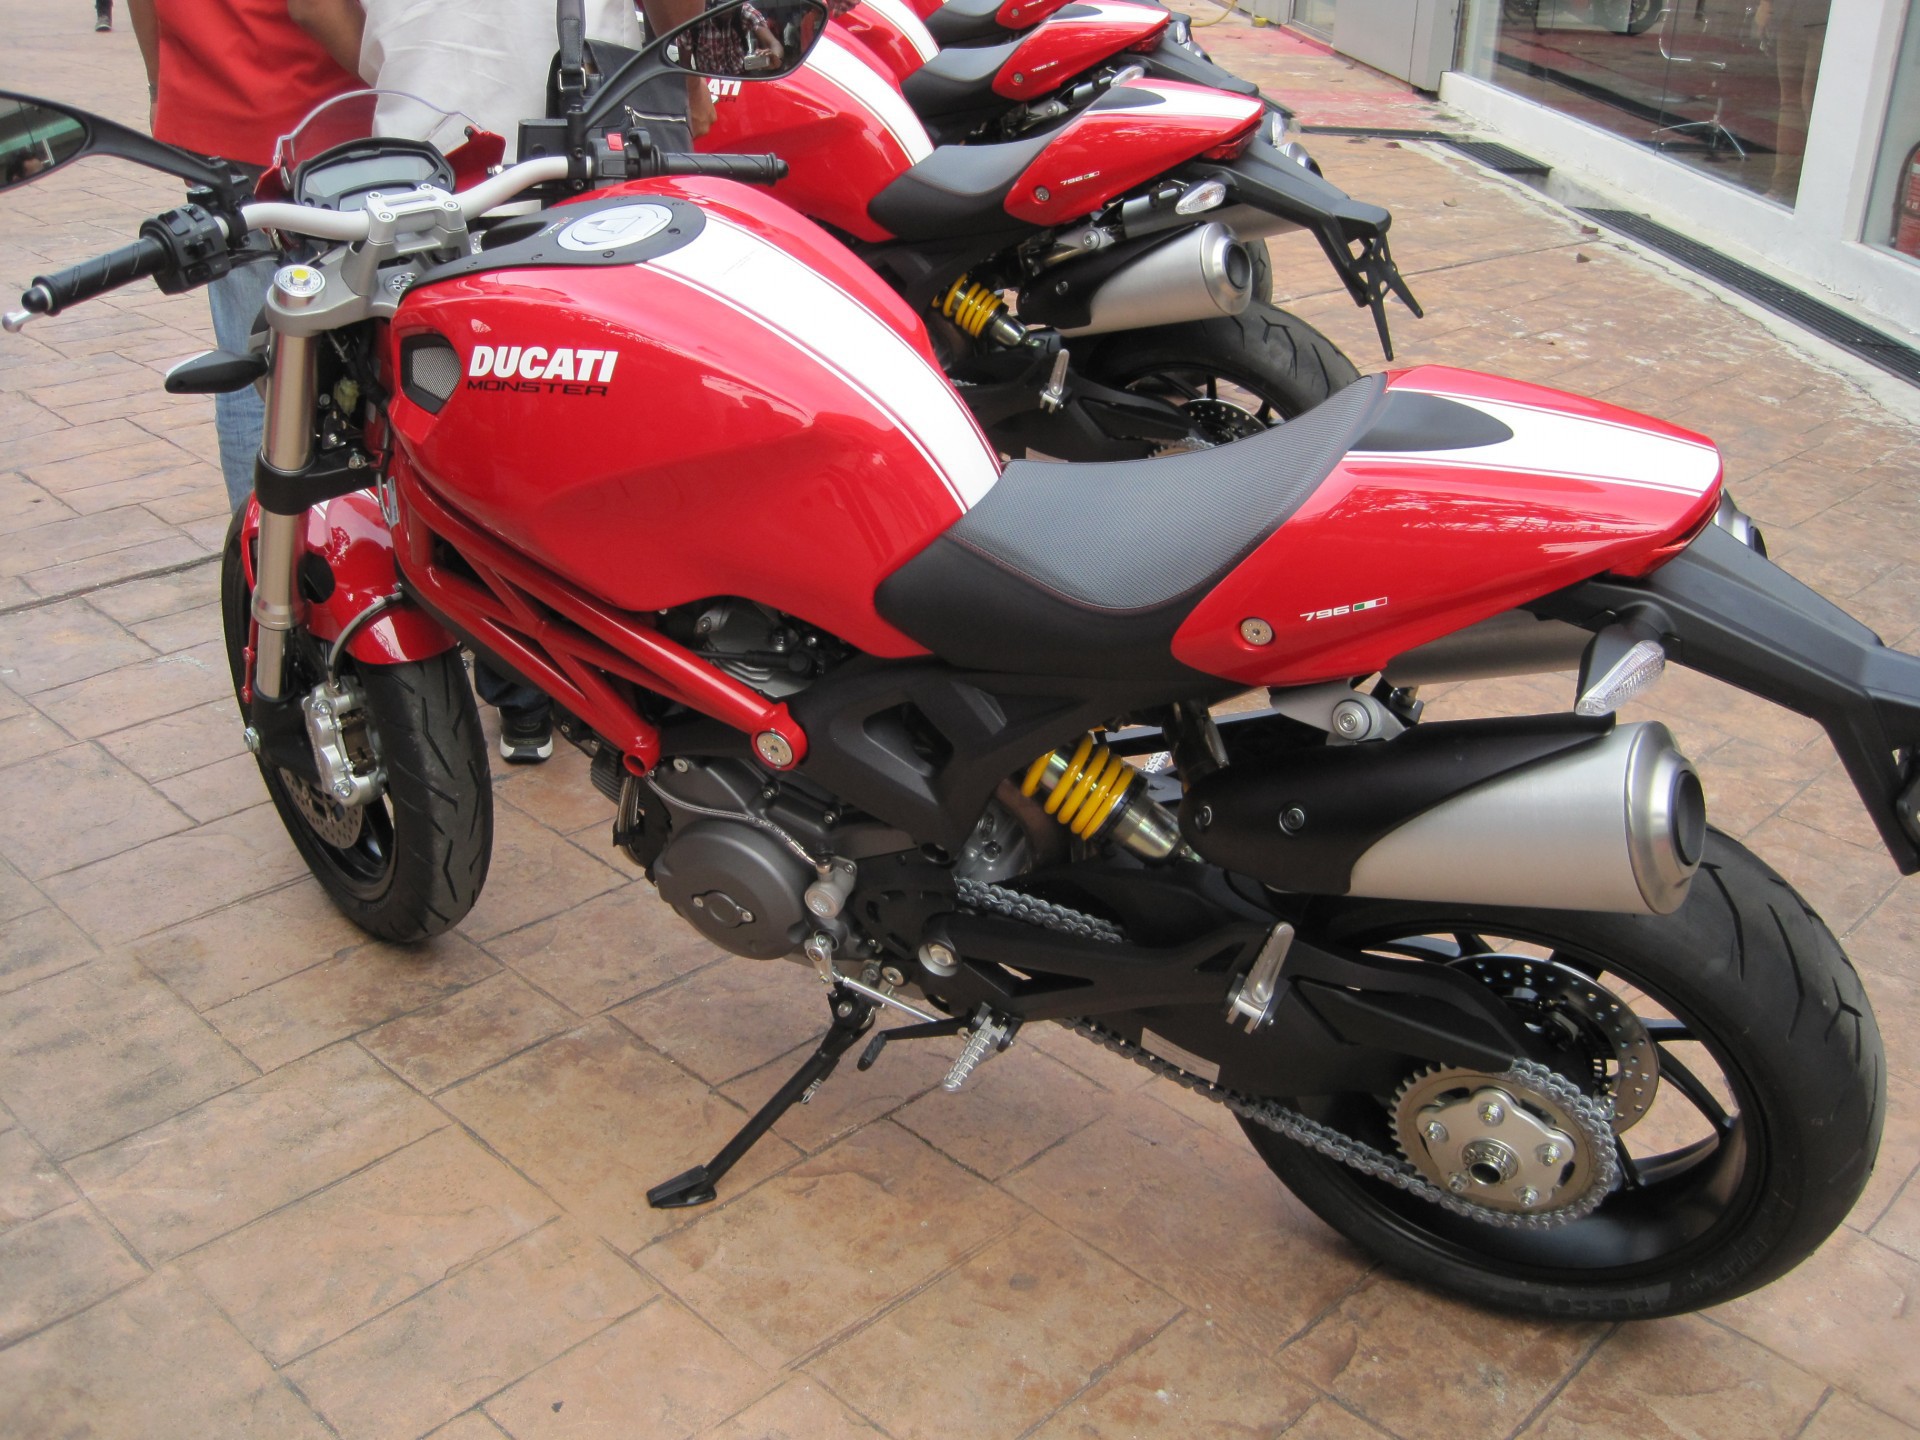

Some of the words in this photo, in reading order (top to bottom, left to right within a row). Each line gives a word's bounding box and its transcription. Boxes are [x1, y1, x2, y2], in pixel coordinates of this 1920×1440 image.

[707, 78, 742, 96] ATI
[468, 345, 619, 383] DUCATI
[467, 379, 609, 397] MONSTER
[1299, 605, 1350, 622] 796
